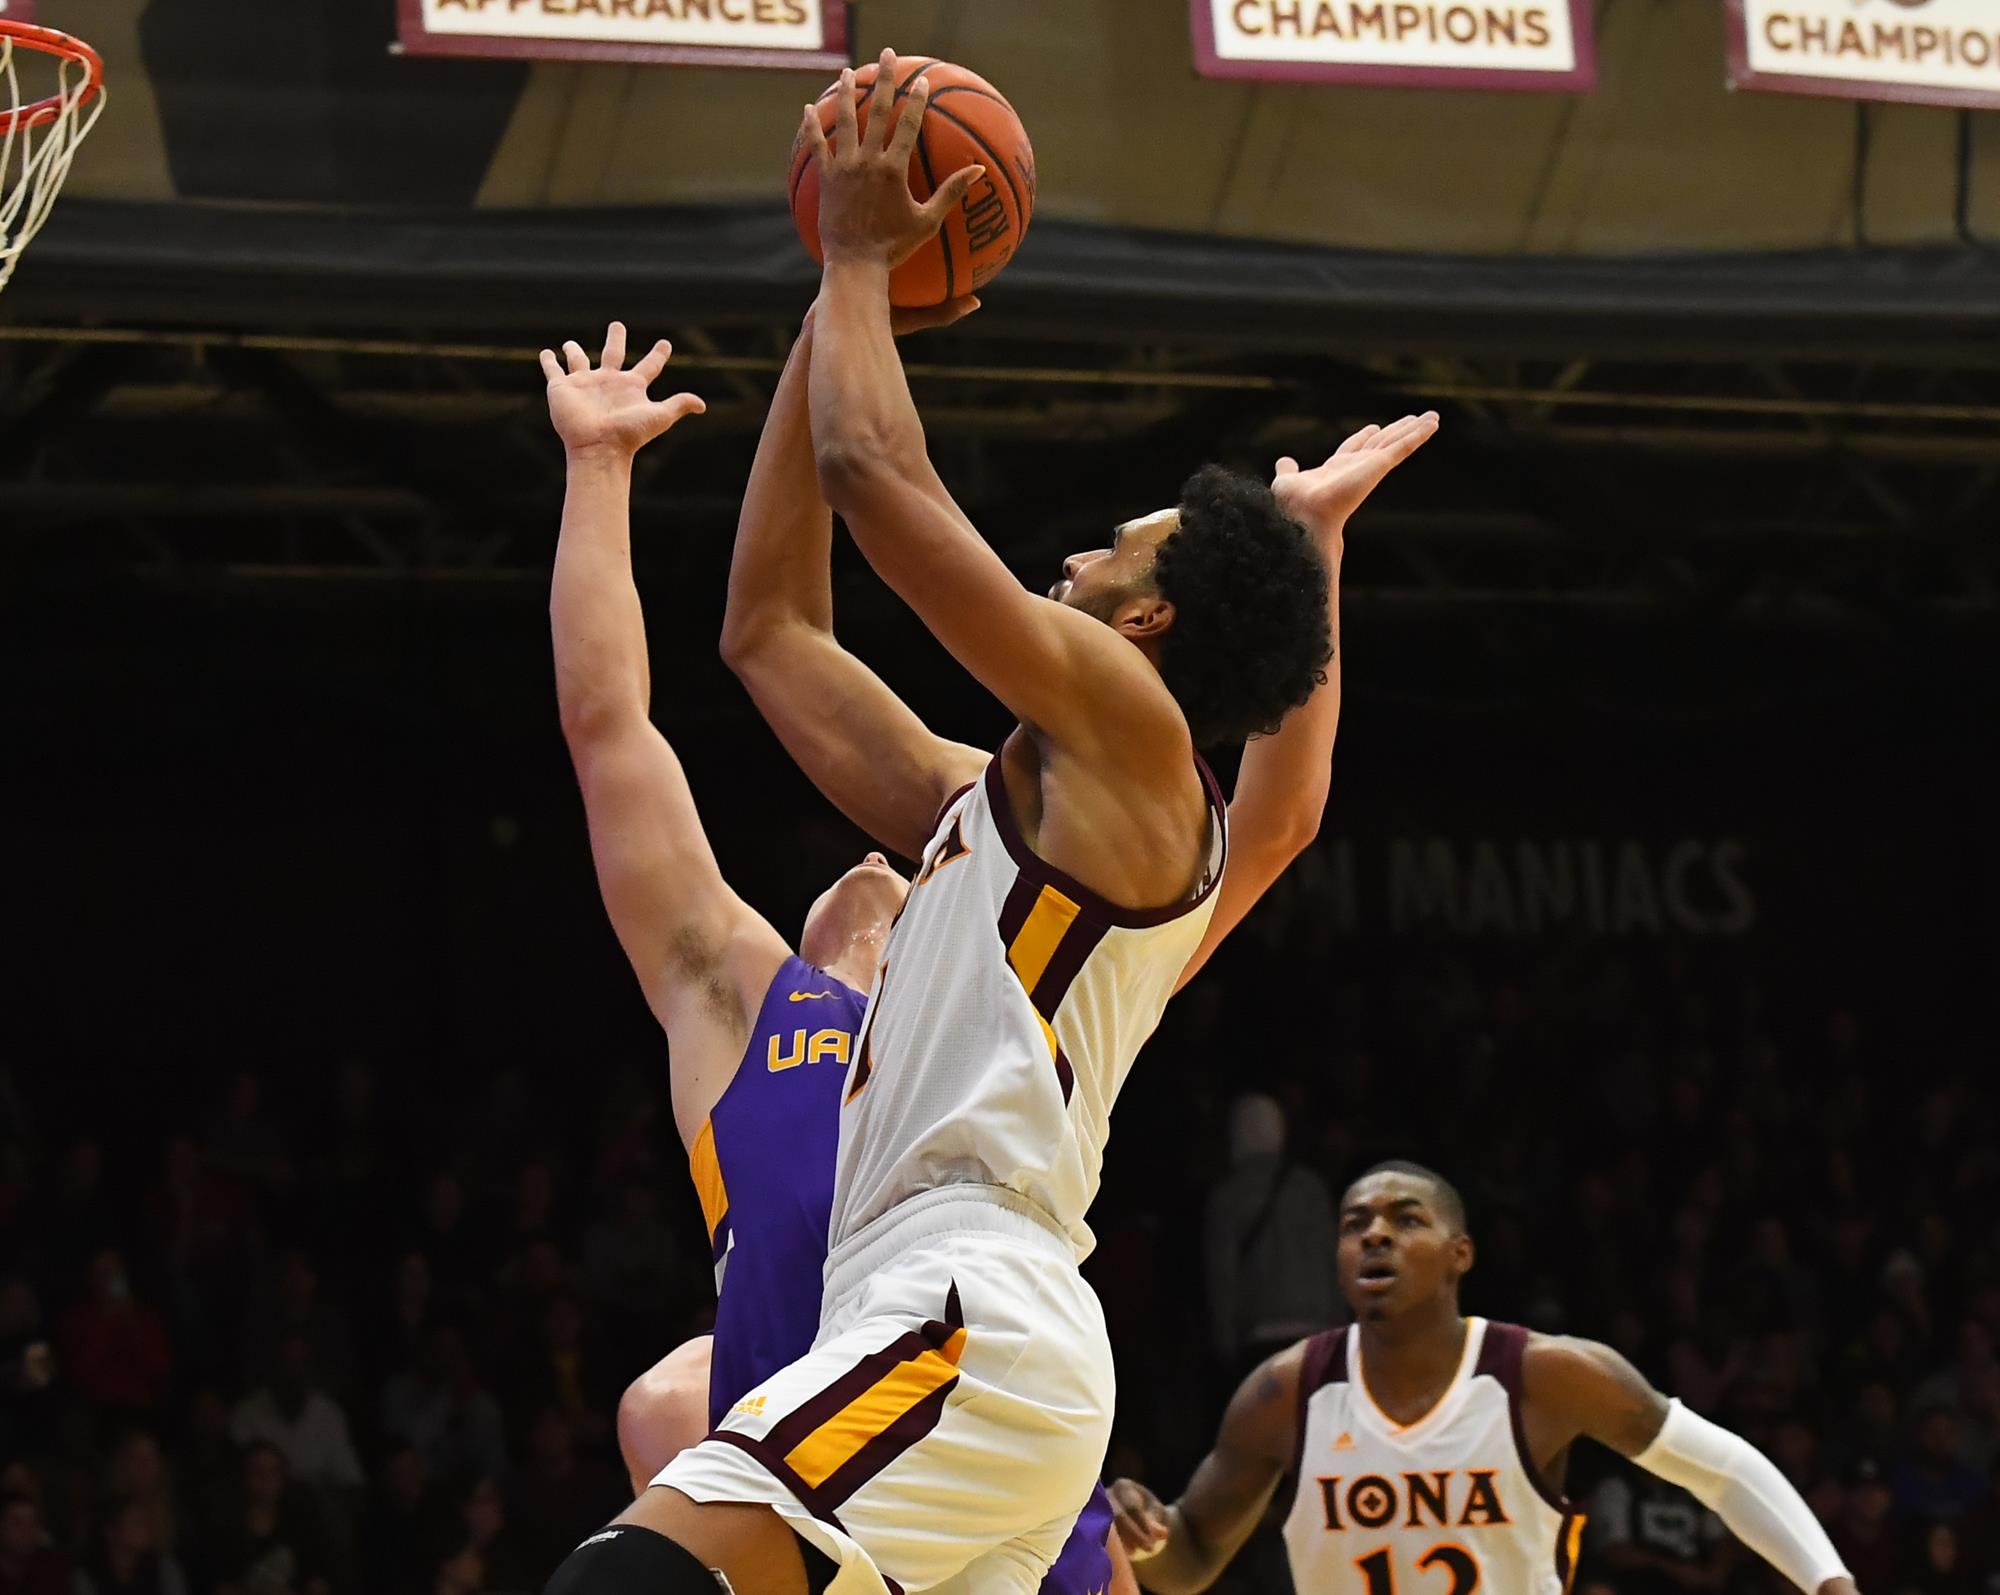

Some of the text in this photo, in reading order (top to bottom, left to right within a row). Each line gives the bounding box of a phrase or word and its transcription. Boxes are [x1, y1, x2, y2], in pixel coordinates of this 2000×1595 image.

[1232, 0, 1551, 47] CHAMPIONS
[1765, 14, 2000, 66] CHAMPIO
[961, 163, 1010, 246] ROC
[1388, 838, 1757, 936] MANIACS
[767, 1028, 858, 1073] UA
[1316, 1468, 1514, 1531] IONA
